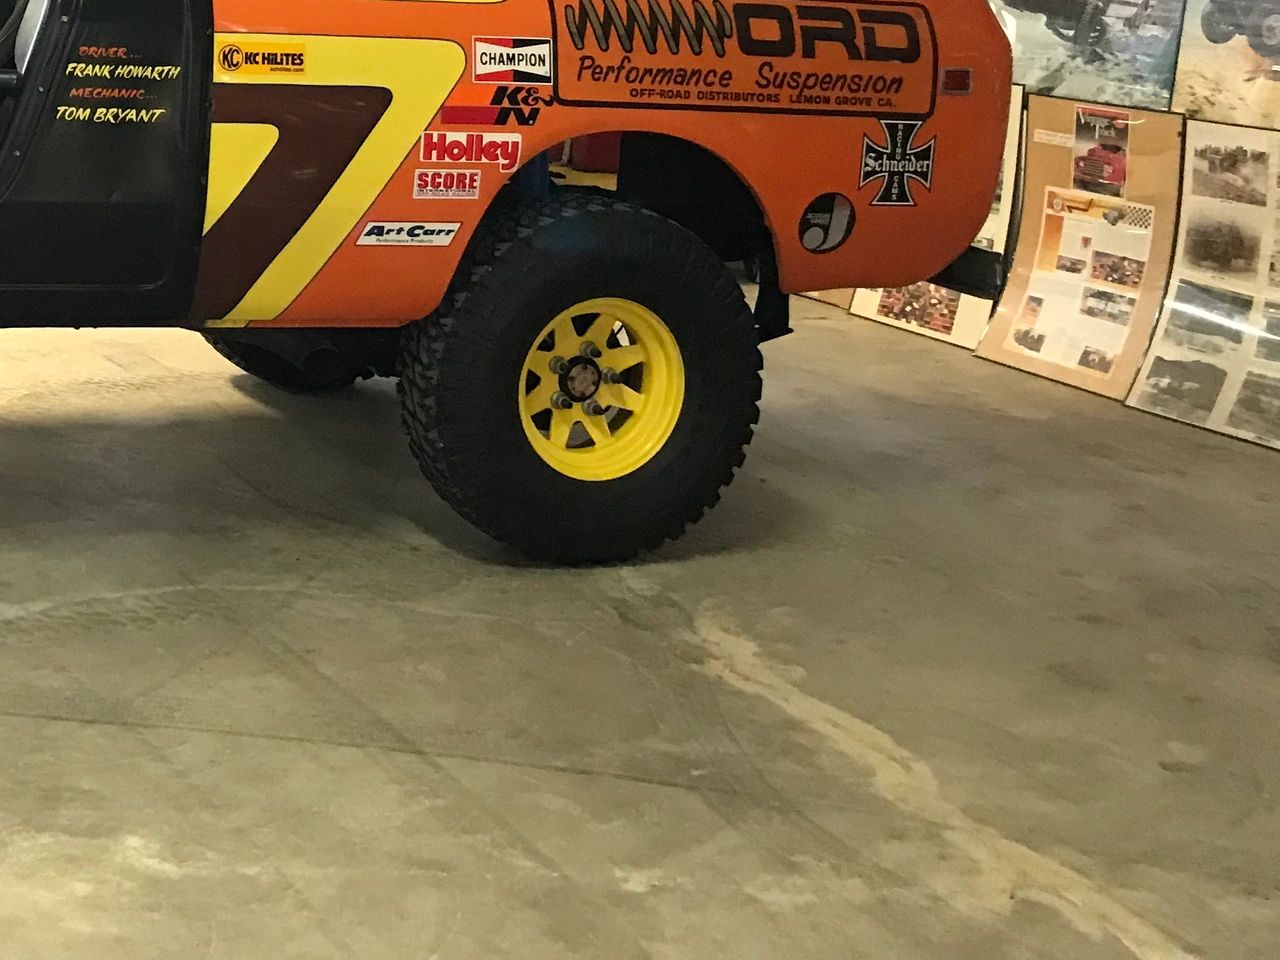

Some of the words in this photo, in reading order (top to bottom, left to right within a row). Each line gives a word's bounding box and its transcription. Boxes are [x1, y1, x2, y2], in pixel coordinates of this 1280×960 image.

[733, 2, 921, 64] ORD
[222, 46, 241, 69] KC
[245, 52, 260, 65] KC
[480, 51, 546, 67] CHAMPION
[65, 63, 115, 80] FRANK
[115, 65, 182, 81] HOWARTH
[577, 55, 733, 89] Performance
[754, 61, 904, 96] Suspension
[629, 87, 691, 100] OFF-ROAD
[697, 90, 780, 103] DISTRIBUTORS
[789, 93, 831, 106] LEMON
[834, 95, 873, 107] GROVE
[877, 97, 897, 107] CA.
[56, 106, 91, 121] TOM
[93, 108, 166, 123] BRYANT
[422, 133, 520, 171] Holley
[895, 124, 904, 160] RACING
[864, 152, 930, 172] Schneider
[417, 172, 478, 189] SCORE
[891, 175, 899, 201] CAMS
[364, 225, 405, 237] Art
[406, 224, 455, 238] Carr
